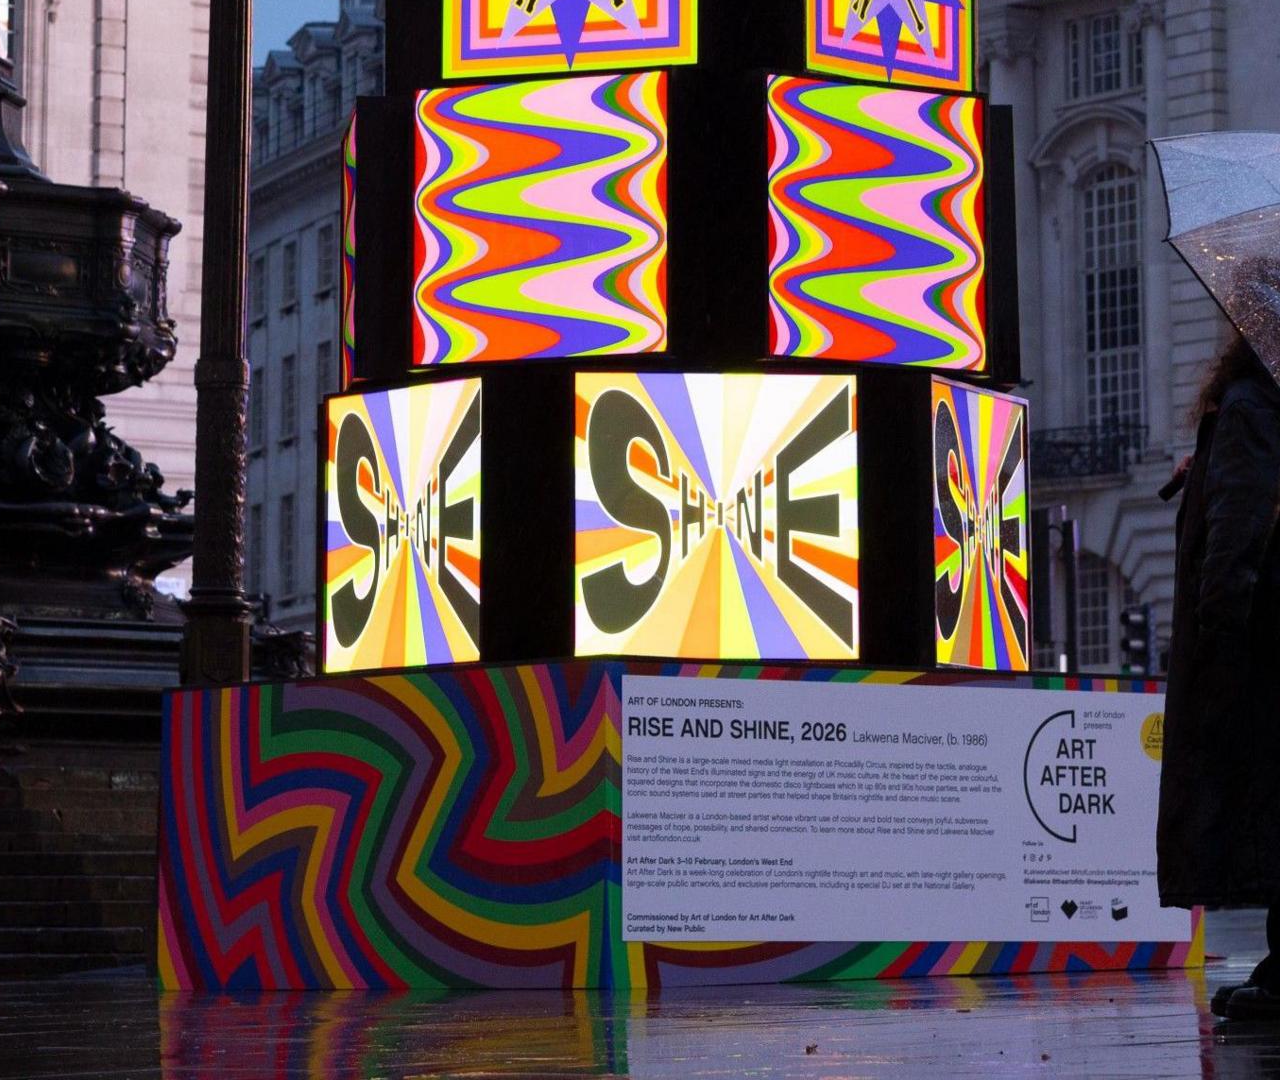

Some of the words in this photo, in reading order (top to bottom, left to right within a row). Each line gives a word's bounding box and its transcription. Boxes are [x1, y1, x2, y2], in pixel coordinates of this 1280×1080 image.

[331, 384, 482, 656] SHINE
[582, 382, 855, 653] SHINE
[934, 399, 1028, 671] SHINE
[628, 697, 644, 706] ART
[646, 697, 658, 707] OF
[660, 698, 696, 708] LONDON
[698, 699, 744, 709] PRESENTS:
[1102, 710, 1125, 719] london
[628, 716, 674, 736] RISE
[680, 717, 723, 737] AND
[729, 719, 794, 742] SHINE,
[800, 720, 847, 740] 2026
[1083, 722, 1113, 731] presents
[853, 731, 899, 744] Lakwena
[902, 732, 943, 747] Maciver,
[946, 734, 959, 748] (b.
[962, 734, 988, 748] 1986)
[1056, 738, 1097, 760] ART
[1040, 765, 1107, 787] AFTER
[1059, 793, 1116, 815] DARK
[627, 856, 637, 864] Art
[639, 856, 656, 864] After
[658, 856, 674, 865] Dark
[676, 856, 692, 865] 3–10
[694, 857, 726, 867] February,
[761, 857, 777, 865] West
[779, 857, 792, 866] End
[627, 913, 678, 921] Commissioned
[690, 913, 700, 921] Art
[711, 913, 736, 921] London
[738, 913, 747, 921] for
[749, 913, 759, 921] Art
[761, 913, 776, 921] After
[778, 913, 794, 921] Dark
[627, 924, 654, 932] Curated
[667, 924, 682, 932] New
[684, 924, 705, 932] Public
